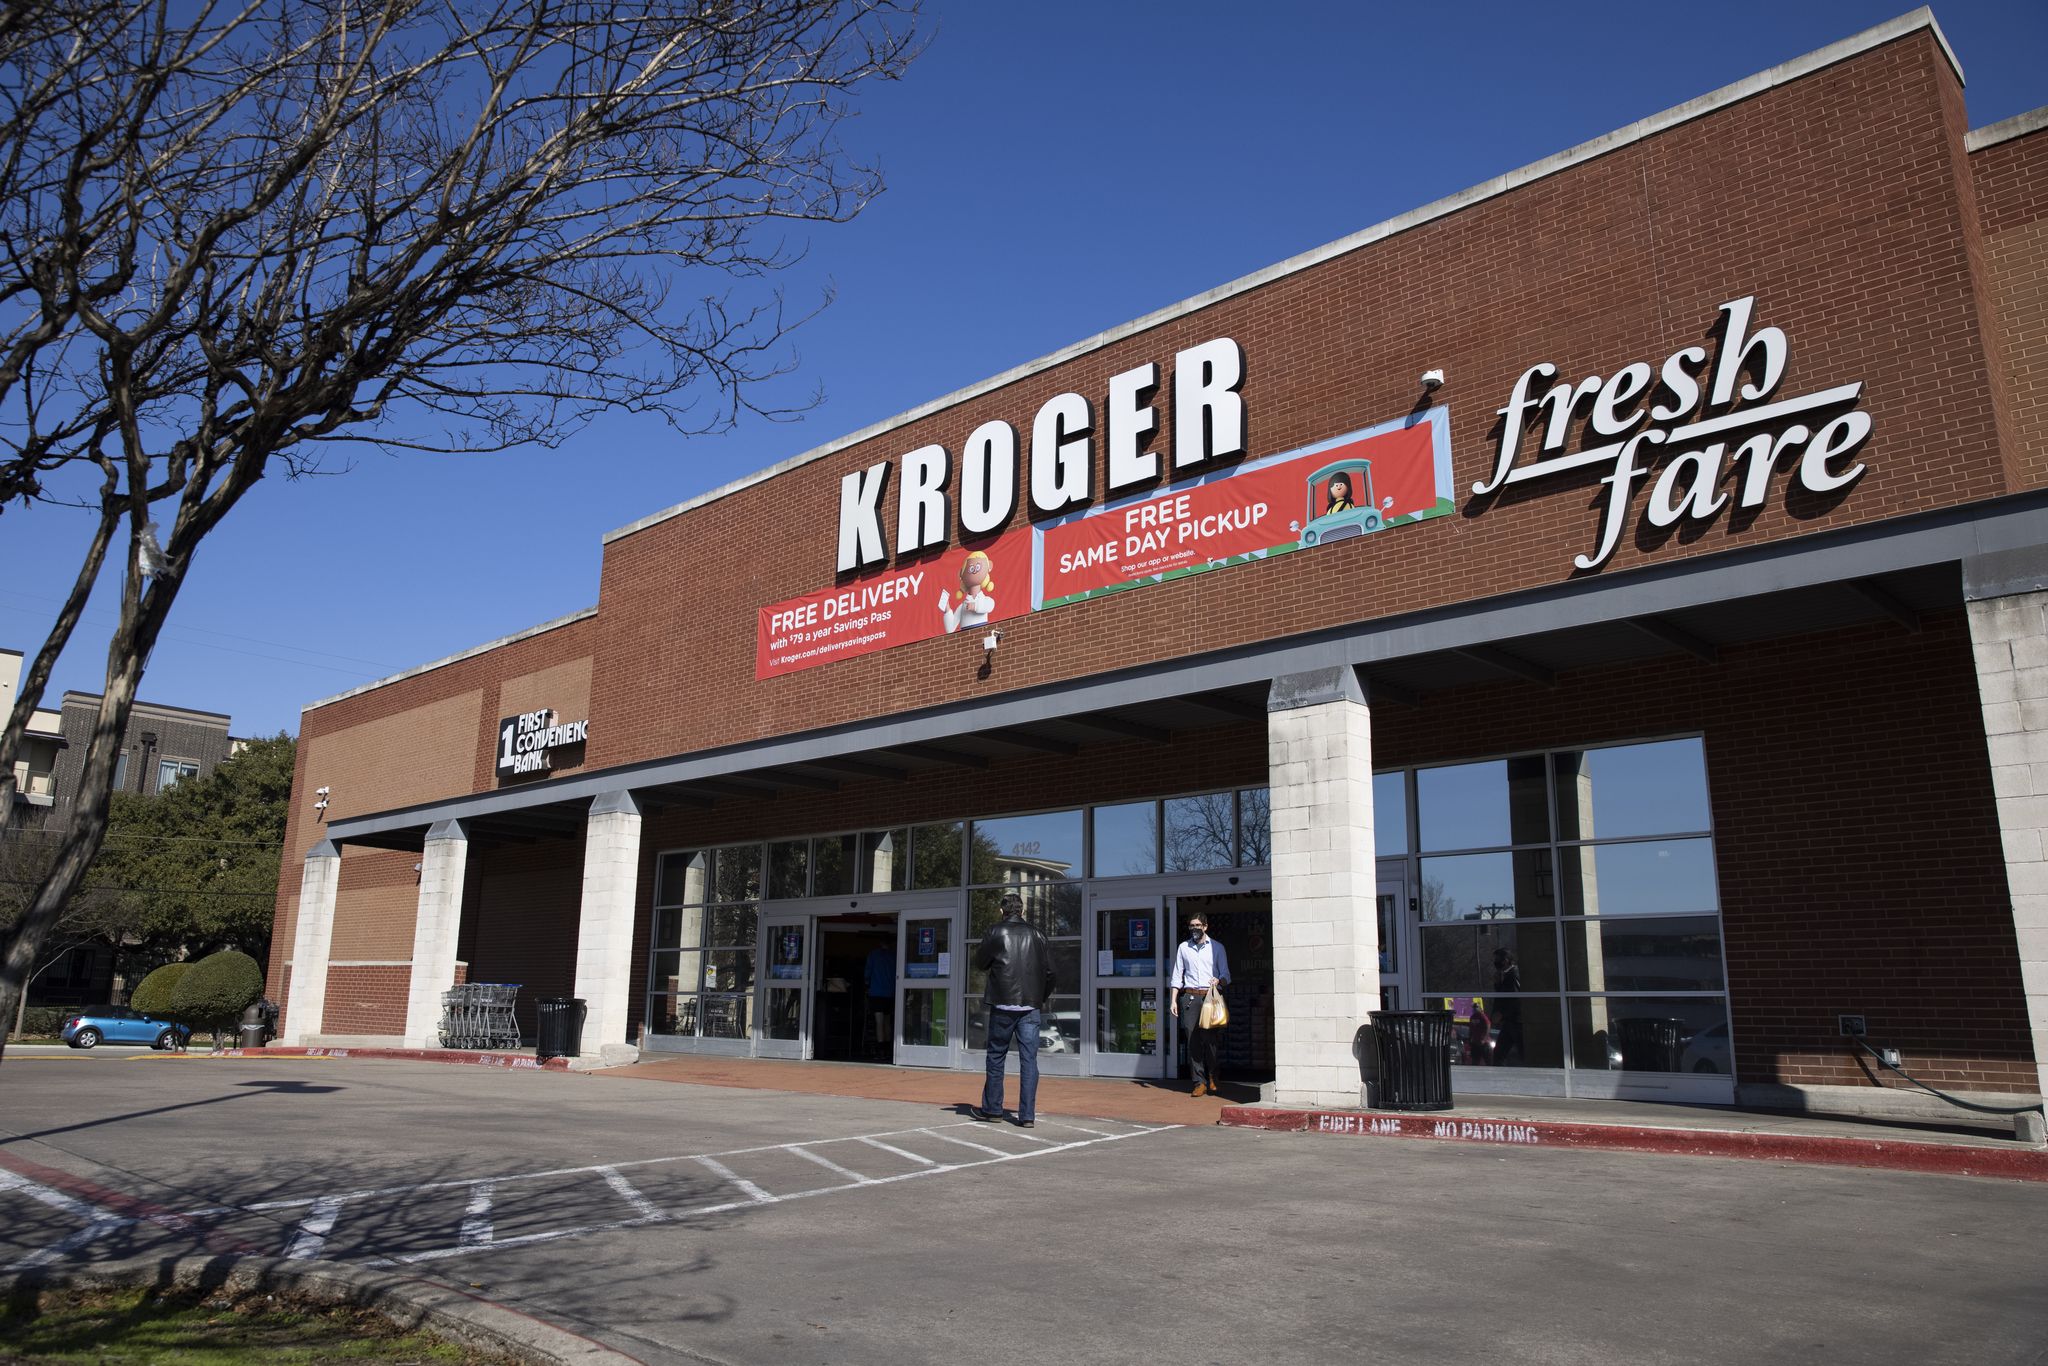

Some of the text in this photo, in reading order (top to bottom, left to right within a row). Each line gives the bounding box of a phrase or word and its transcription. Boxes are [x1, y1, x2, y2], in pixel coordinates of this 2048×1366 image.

[1471, 295, 1788, 494] fresh
[837, 337, 1247, 573] KROGER
[1574, 410, 1873, 569] fare
[1125, 495, 1191, 533] FREE
[1059, 541, 1118, 574] SAME
[1125, 527, 1171, 557] DAY
[1178, 502, 1268, 544] PICKUP
[1121, 564, 1136, 573] Shop
[1148, 557, 1161, 566] app
[771, 571, 924, 635] FREE DELIVERY
[769, 630, 886, 667] Visit Kroger.com/deliverysavingspass
[770, 610, 892, 651] with $79 a year Savings Pass
[518, 708, 547, 734] FIRST
[500, 724, 515, 768] 1
[514, 750, 543, 774] BANK
[1012, 841, 1040, 856] 4142
[1320, 1115, 1538, 1143] FIRE LANE NO PARKING
